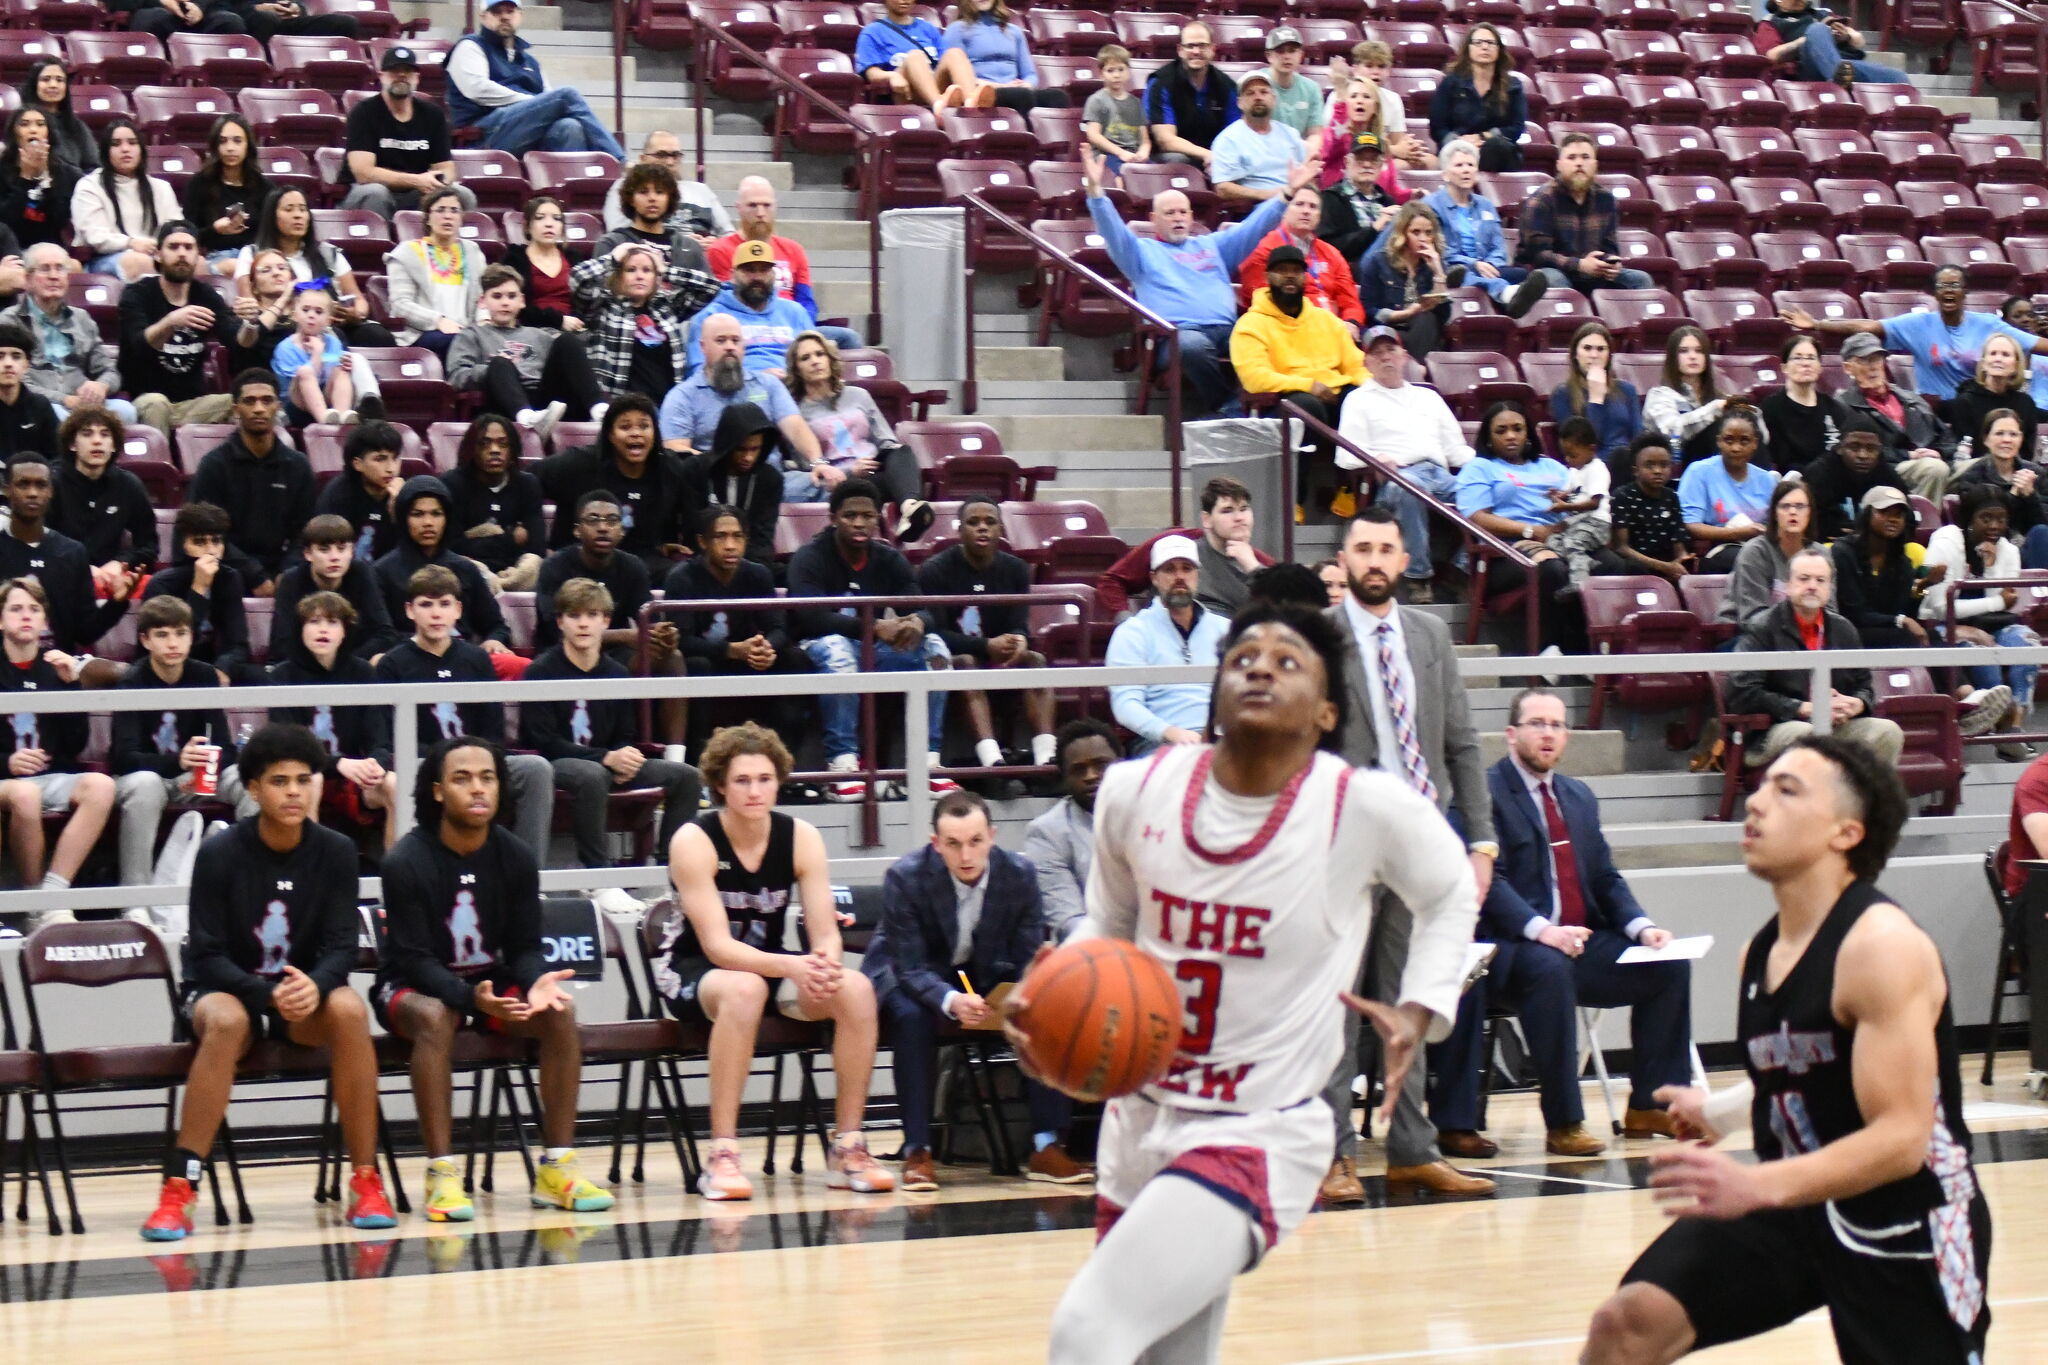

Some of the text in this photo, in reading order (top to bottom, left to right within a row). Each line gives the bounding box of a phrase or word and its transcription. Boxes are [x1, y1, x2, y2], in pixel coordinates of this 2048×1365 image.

[1152, 888, 1271, 959] THE
[44, 941, 147, 962] ABERNATHY
[541, 936, 595, 963] ORE
[1176, 958, 1223, 1056] 3
[1156, 1058, 1256, 1102] EW
